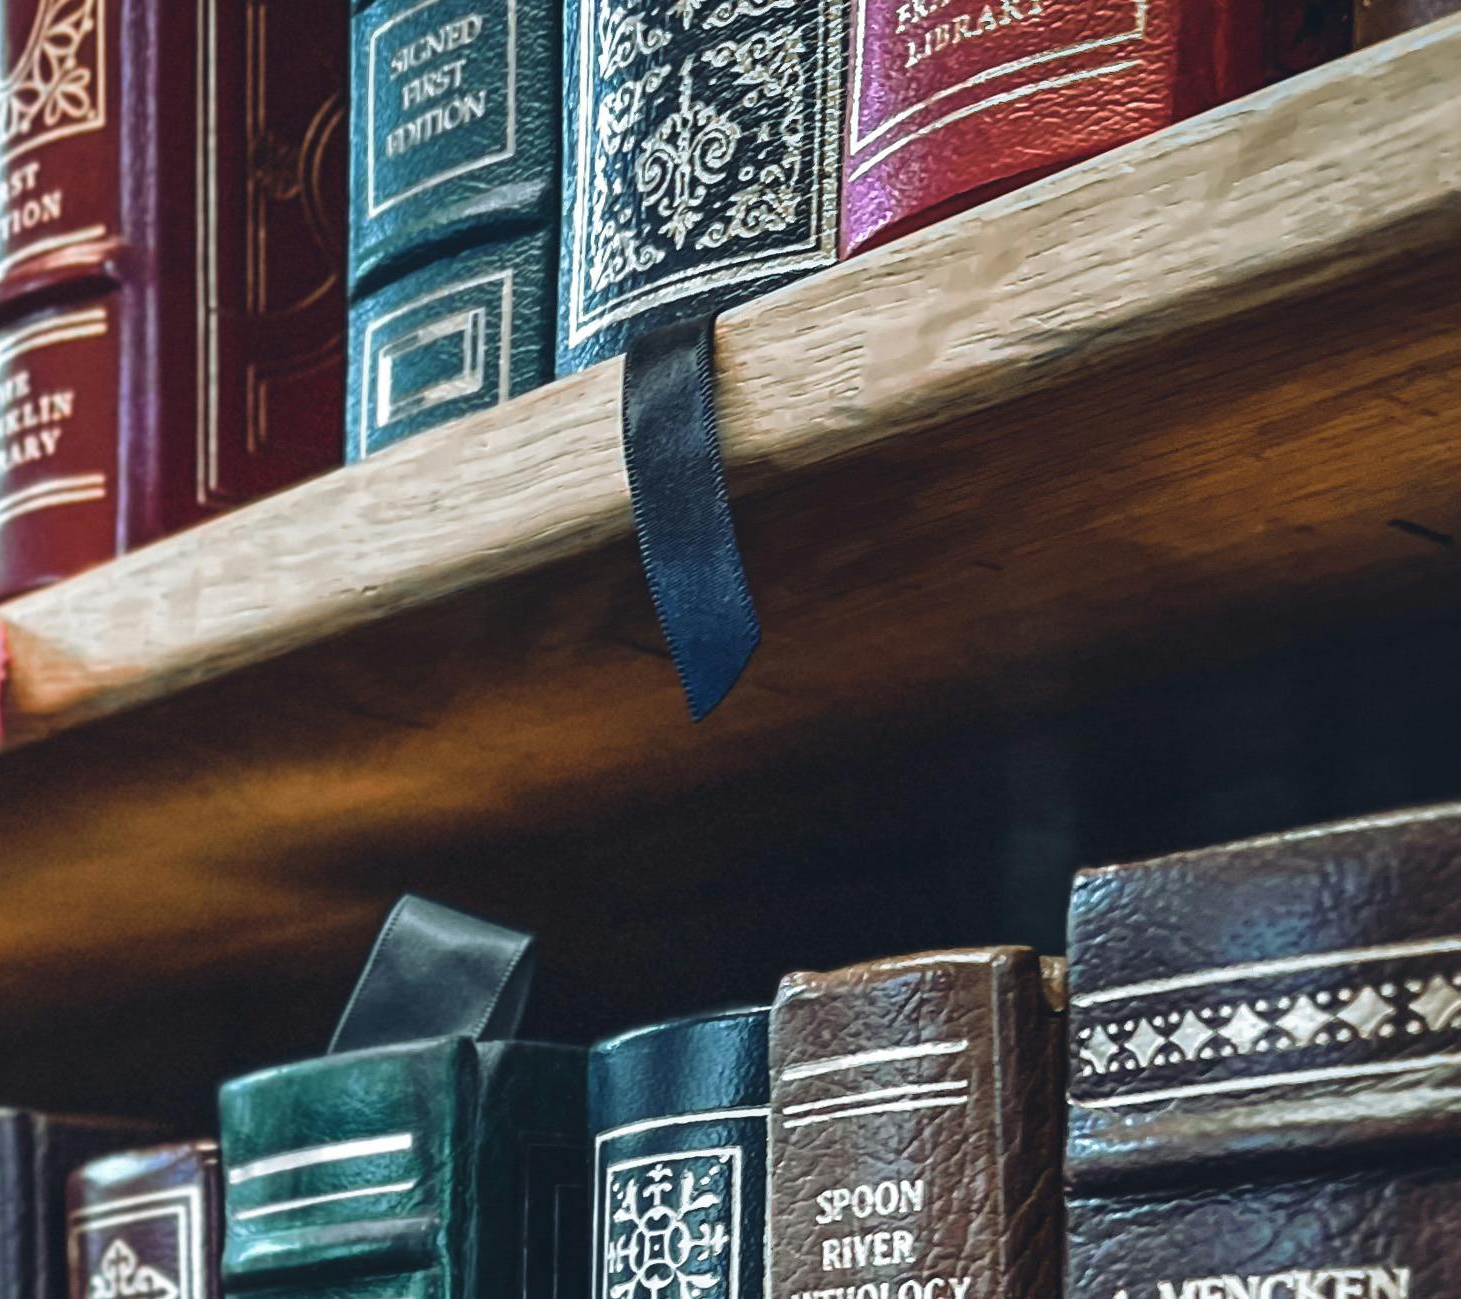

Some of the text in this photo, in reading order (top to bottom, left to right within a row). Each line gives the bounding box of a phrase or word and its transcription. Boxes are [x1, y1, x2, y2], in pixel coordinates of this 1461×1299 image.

[390, 13, 484, 80] SIGNED
[402, 58, 467, 111] FIRST
[386, 89, 488, 159] EDITION
[815, 1179, 925, 1225] SPOON
[822, 1230, 916, 1271] RIVER
